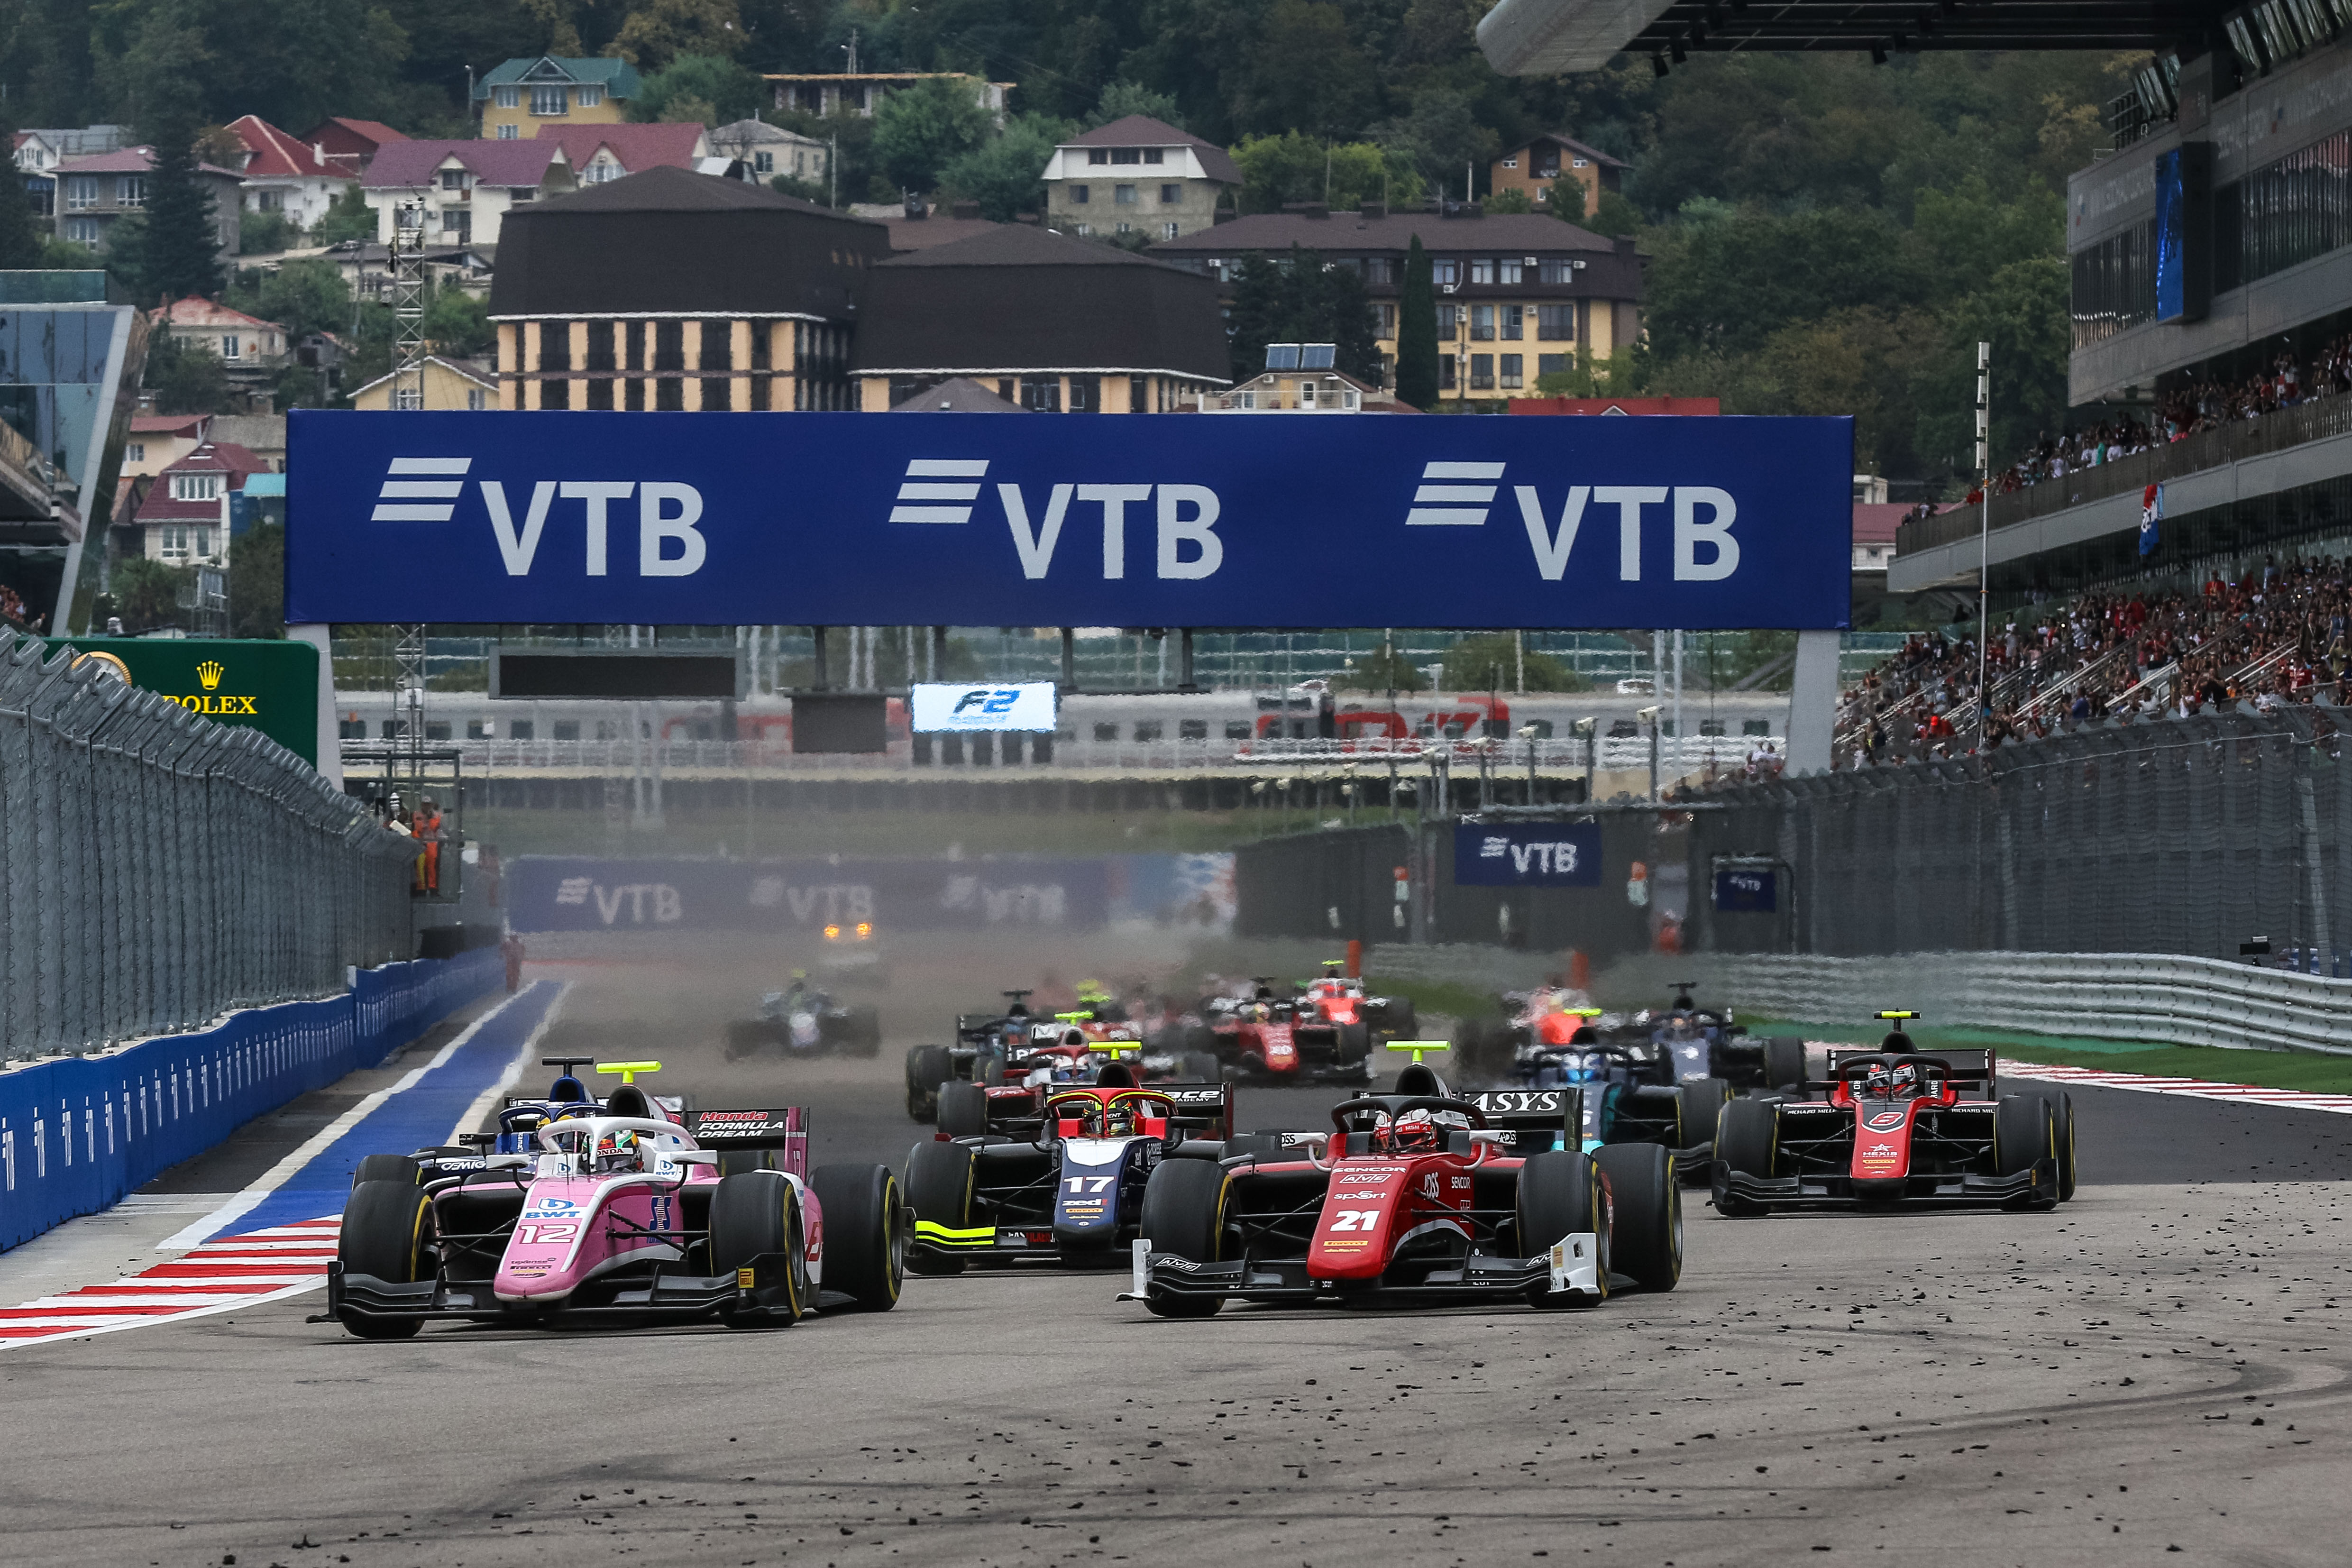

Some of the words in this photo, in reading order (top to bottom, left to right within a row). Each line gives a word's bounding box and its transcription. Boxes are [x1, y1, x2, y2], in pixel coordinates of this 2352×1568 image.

[480, 481, 705, 576] VTB
[998, 484, 1223, 579] VTB
[1514, 486, 1739, 580] VTB
[953, 690, 1021, 713] F2
[1510, 842, 1578, 873] VTB
[594, 884, 682, 924] VTB
[786, 885, 873, 921] VTB
[1152, 1090, 1220, 1099] ace
[1464, 1092, 1560, 1112] ASYS
[699, 1111, 768, 1122] Honda
[1094, 1112, 1122, 1121] TRDENT
[1868, 1111, 1904, 1126] 8
[694, 1130, 763, 1138] DREAM
[698, 1121, 784, 1130] FORMULA
[441, 1161, 486, 1171] CEMIG
[1063, 1176, 1115, 1193] 17
[1452, 1176, 1470, 1189] SENCOR
[1062, 1198, 1102, 1206] zed
[1330, 1210, 1381, 1231] 21
[518, 1224, 578, 1244] 12
[1159, 1258, 1199, 1271] AVE
